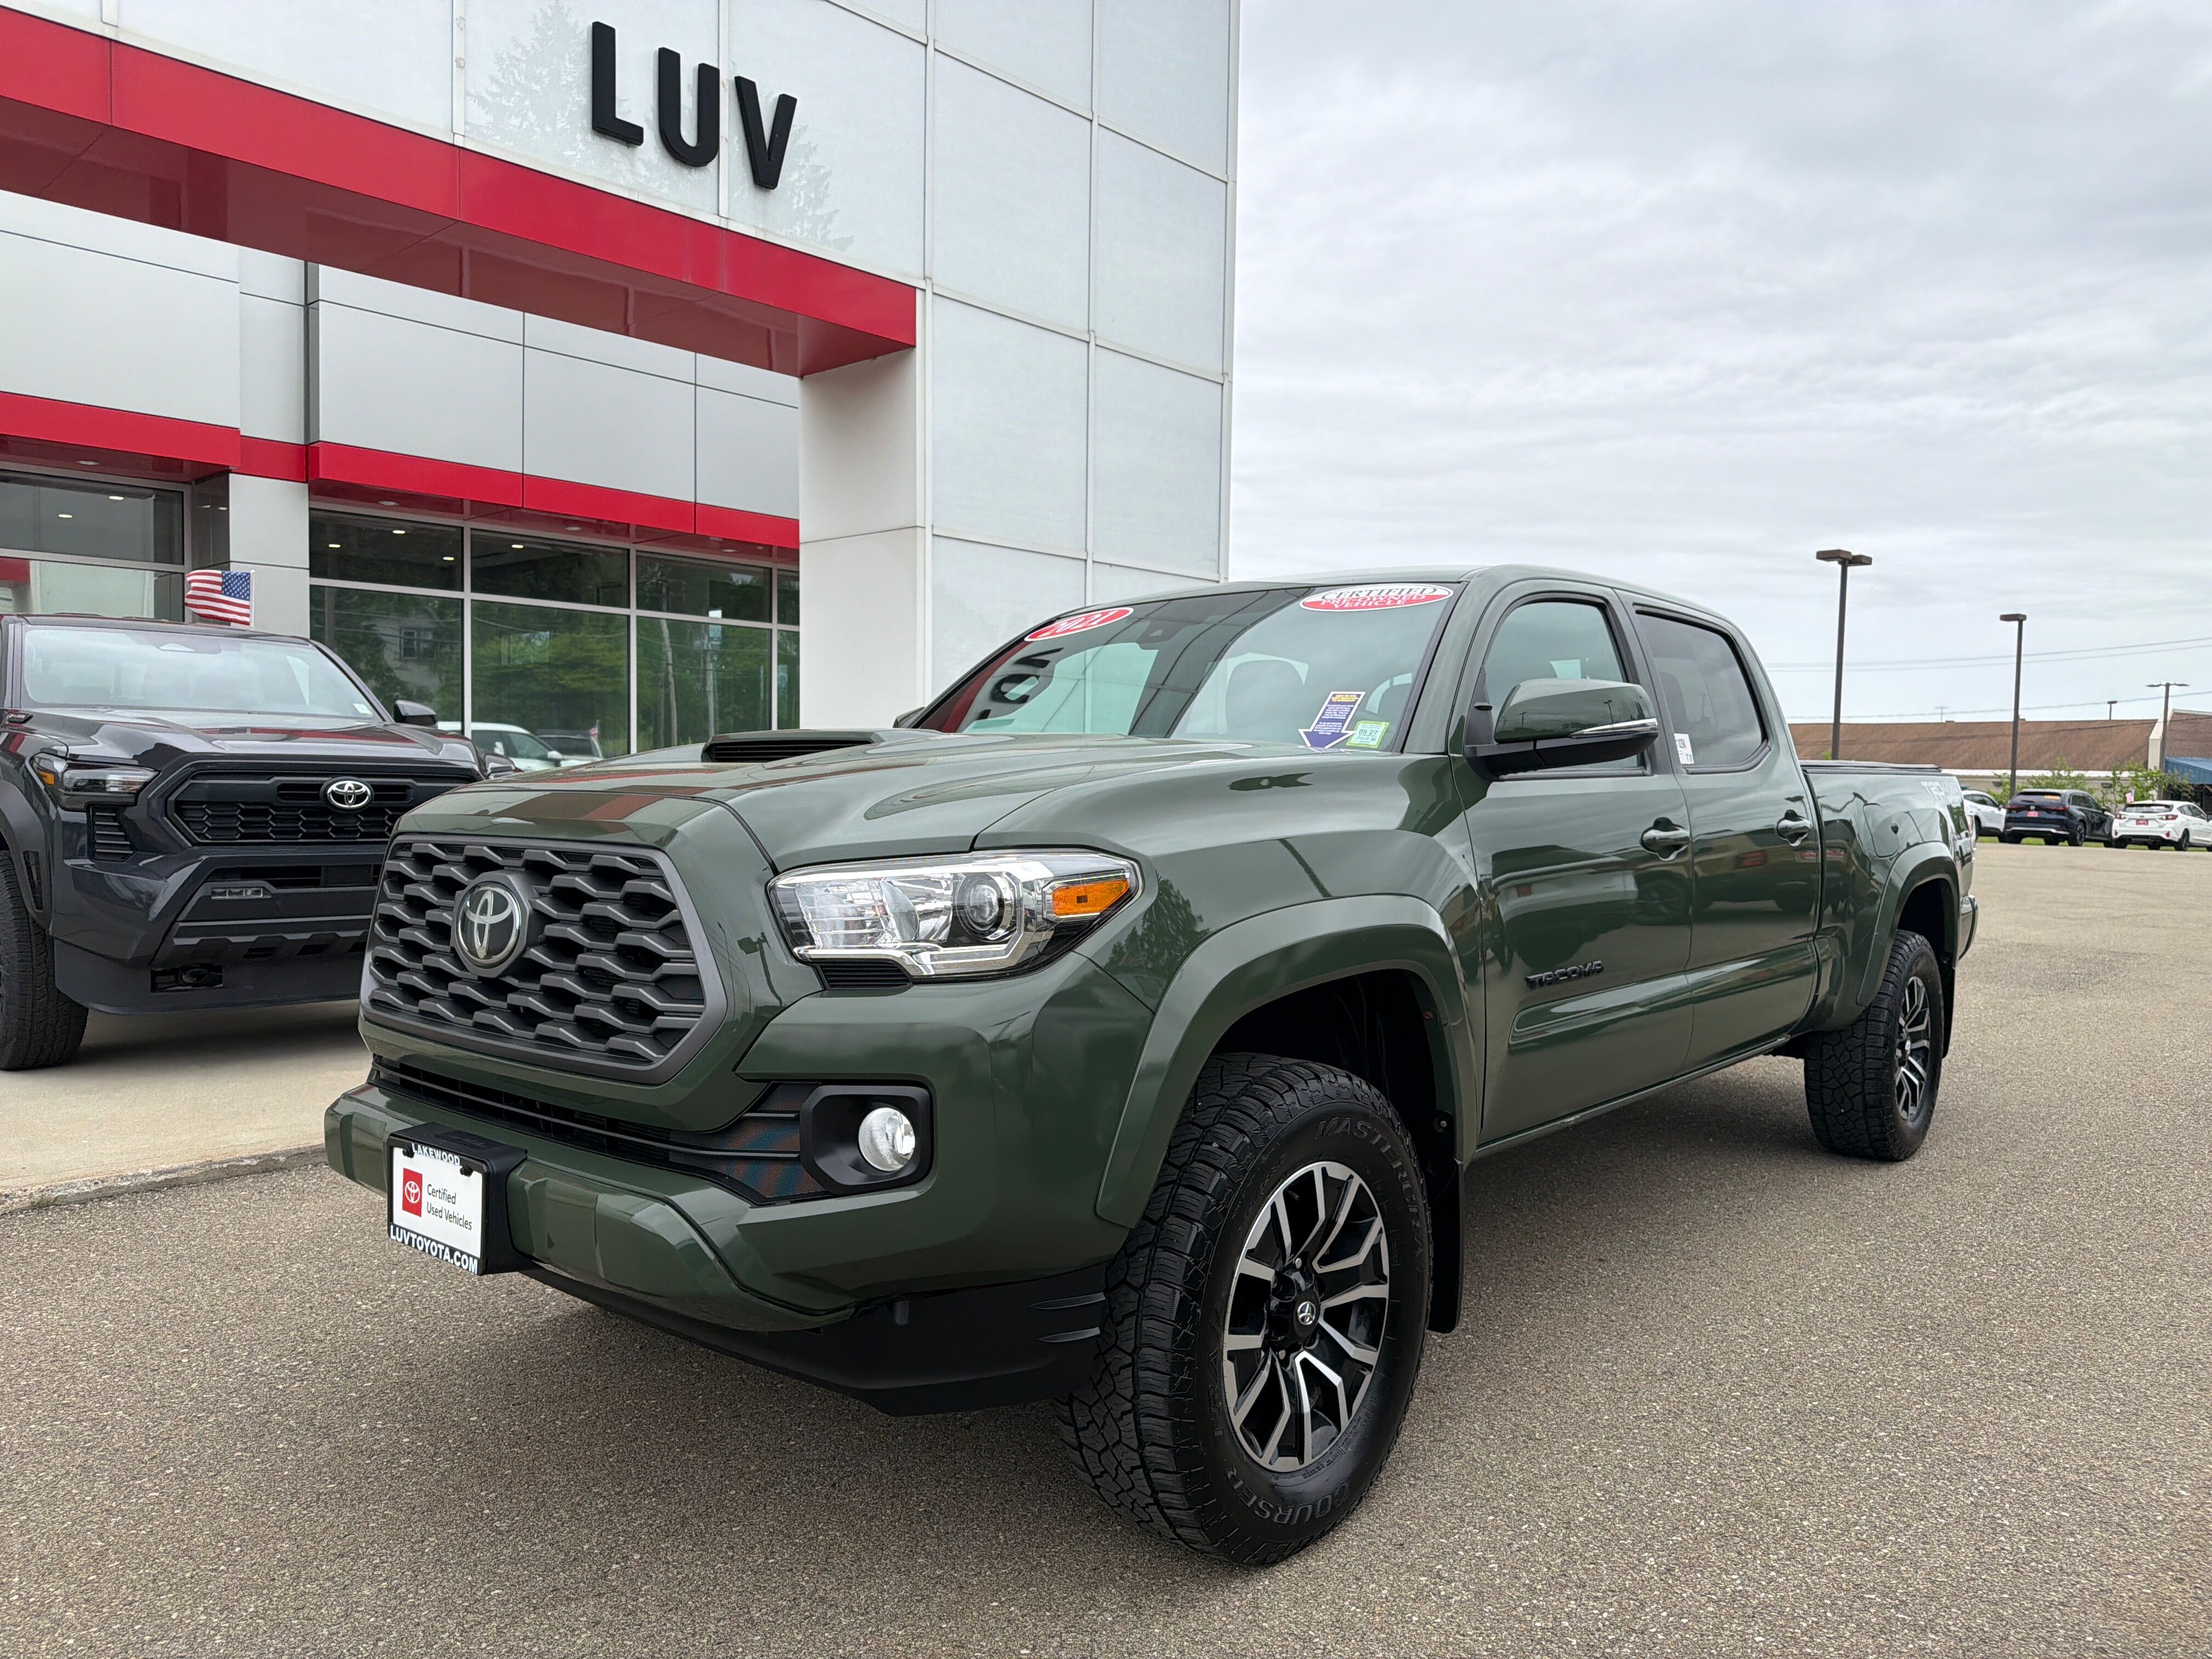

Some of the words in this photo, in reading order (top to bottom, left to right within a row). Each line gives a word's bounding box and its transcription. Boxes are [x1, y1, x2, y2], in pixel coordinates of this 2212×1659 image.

[592, 21, 797, 190] LUV
[1319, 594, 1426, 606] PRE-OWNED
[1321, 587, 1437, 600] CERTIFIED
[1333, 599, 1407, 609] VEHICLE
[1921, 781, 1946, 800] TRD
[1525, 960, 1604, 990] TACOMA
[411, 1143, 460, 1166] LAKEWOOD
[427, 1183, 457, 1205] Certified
[426, 1201, 443, 1219] Used
[444, 1209, 472, 1231] Vehicles
[390, 1224, 478, 1275] LUVTOYOTA.COM
[1224, 1464, 1351, 1526] COURSER
